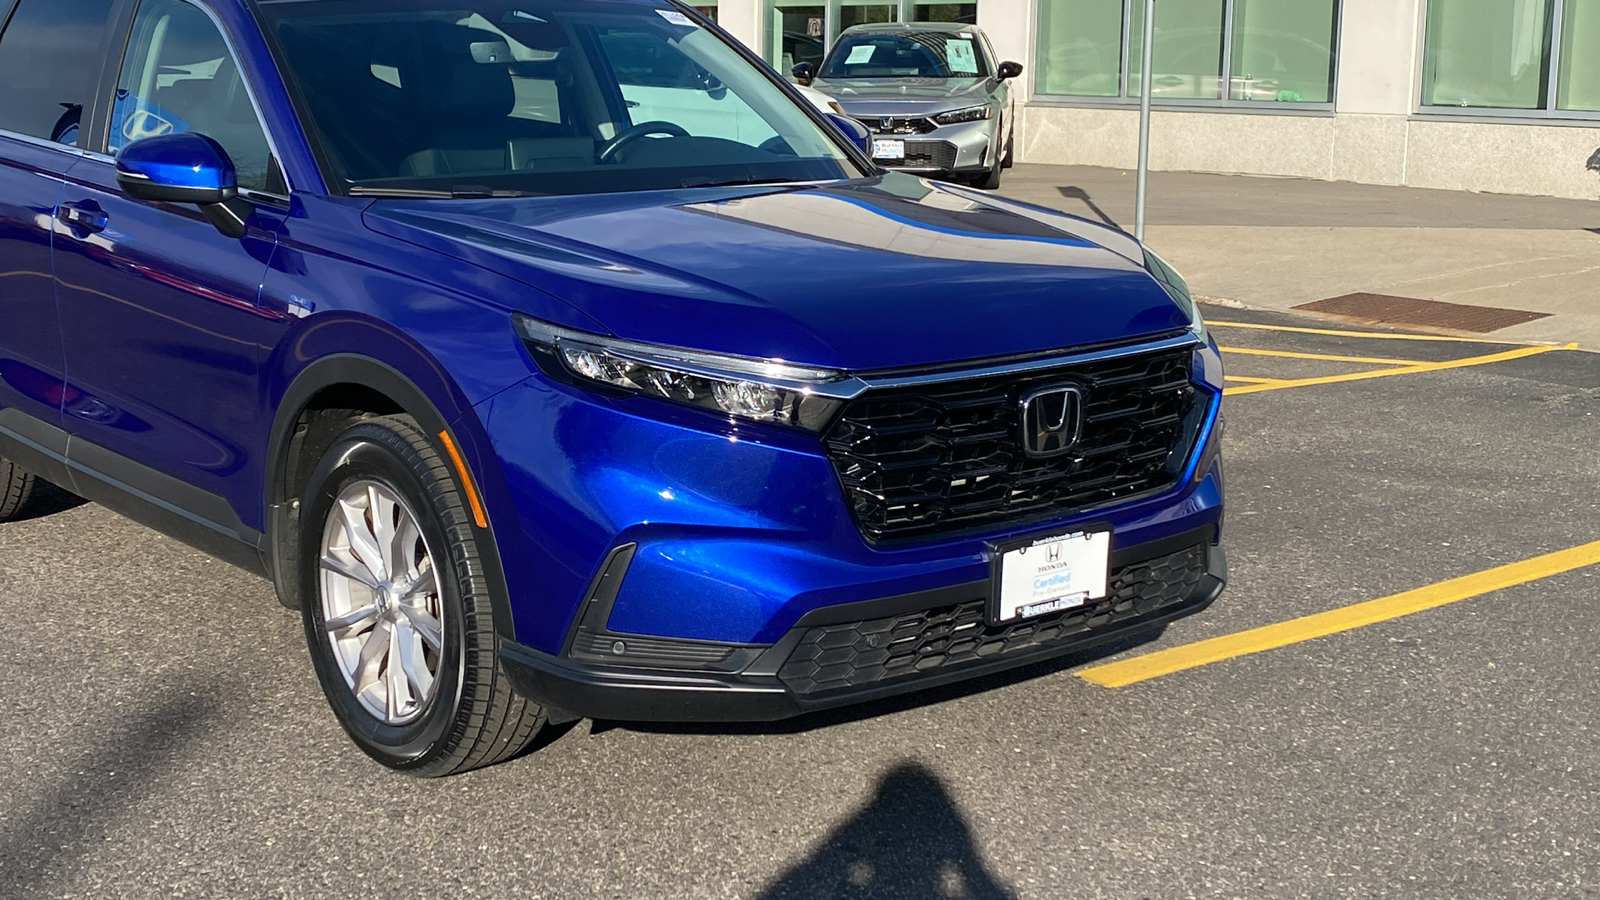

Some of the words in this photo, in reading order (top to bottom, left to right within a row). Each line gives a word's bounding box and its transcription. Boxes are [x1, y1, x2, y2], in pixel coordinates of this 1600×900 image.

[1038, 562, 1067, 572] HONDA
[1034, 573, 1071, 588] Certified
[1033, 584, 1070, 597] Pre-Owned
[1022, 601, 1060, 617] BUERKLE
